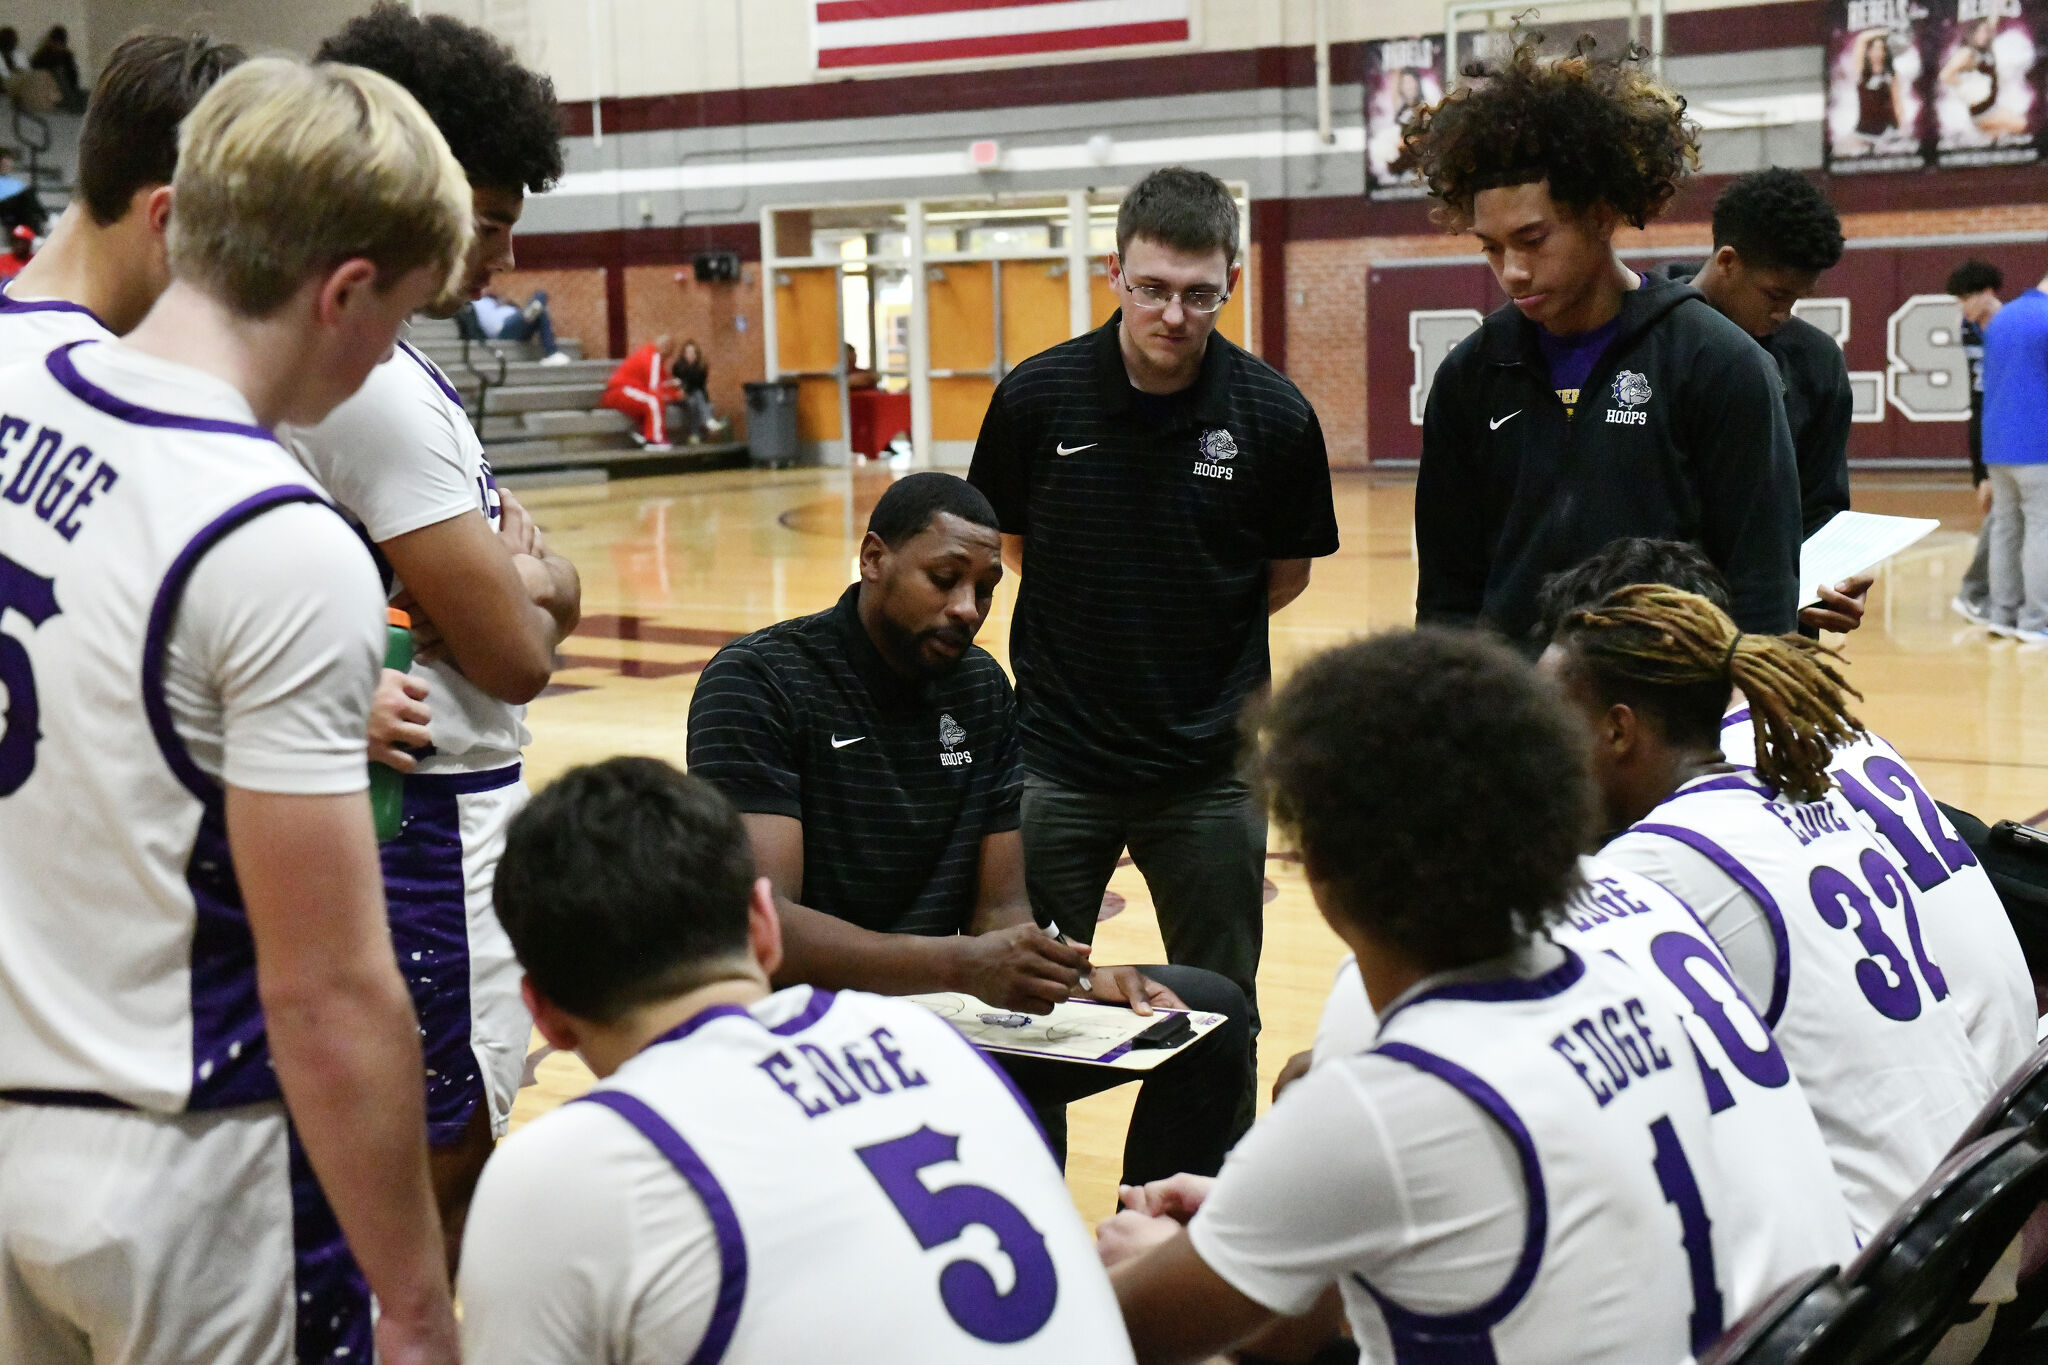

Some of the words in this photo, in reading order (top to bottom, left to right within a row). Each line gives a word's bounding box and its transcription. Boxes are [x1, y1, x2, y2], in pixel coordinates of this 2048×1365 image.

[1193, 461, 1234, 480] HOOPS
[1605, 409, 1648, 425] HOOPS
[940, 750, 973, 766] HOOPS
[1830, 755, 1978, 893] 12
[1809, 847, 1951, 1022] 32
[755, 1027, 929, 1118] EDGE
[1550, 998, 1673, 1109] EDGE
[853, 1123, 1058, 1344] 5
[1648, 1114, 1724, 1360] 1
